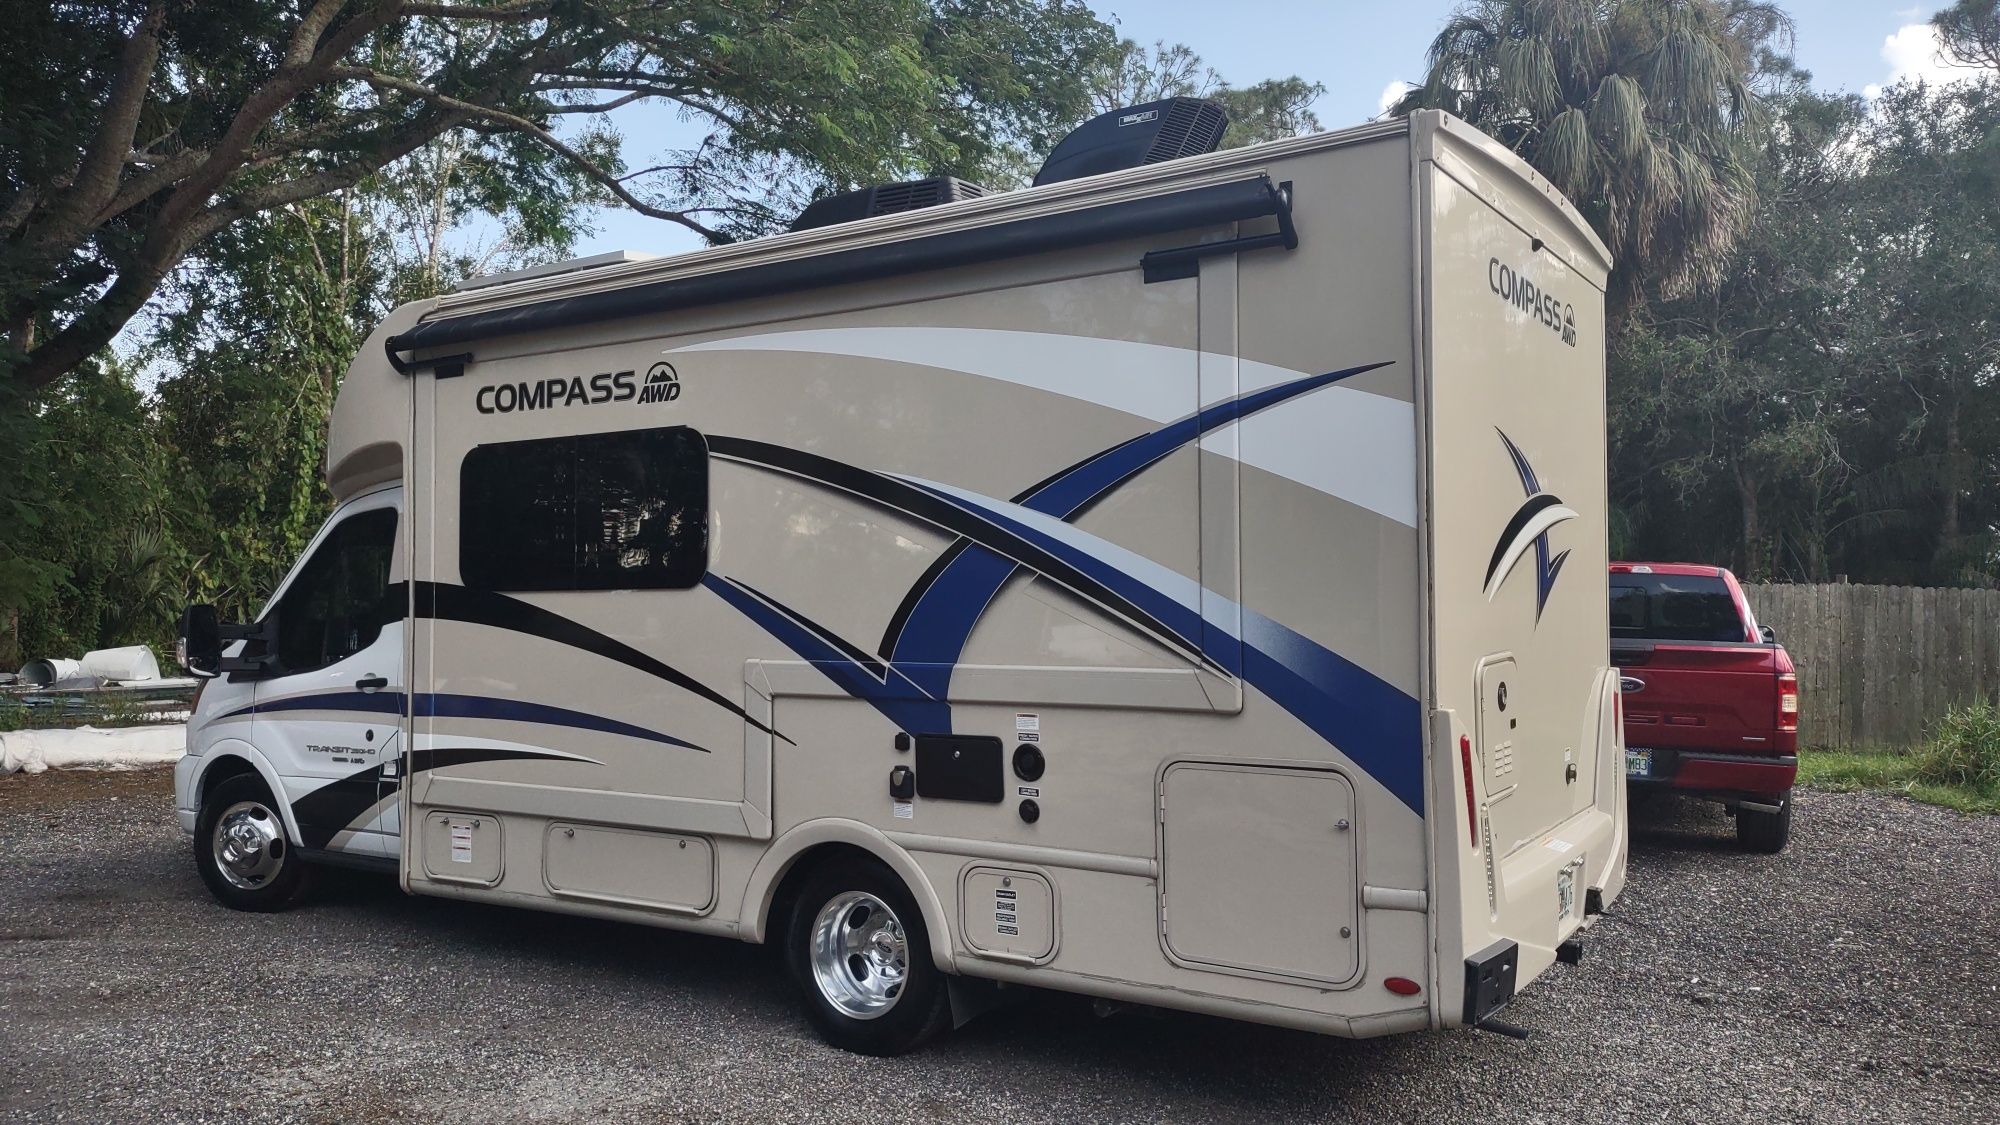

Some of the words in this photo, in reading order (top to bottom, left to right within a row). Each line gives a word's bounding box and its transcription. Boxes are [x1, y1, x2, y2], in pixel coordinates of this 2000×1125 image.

[1489, 257, 1561, 332] COMPASS
[1561, 323, 1577, 348] AWD
[476, 370, 637, 414] COMPASS
[637, 382, 681, 404] AWD
[306, 745, 351, 754] TRANSIT
